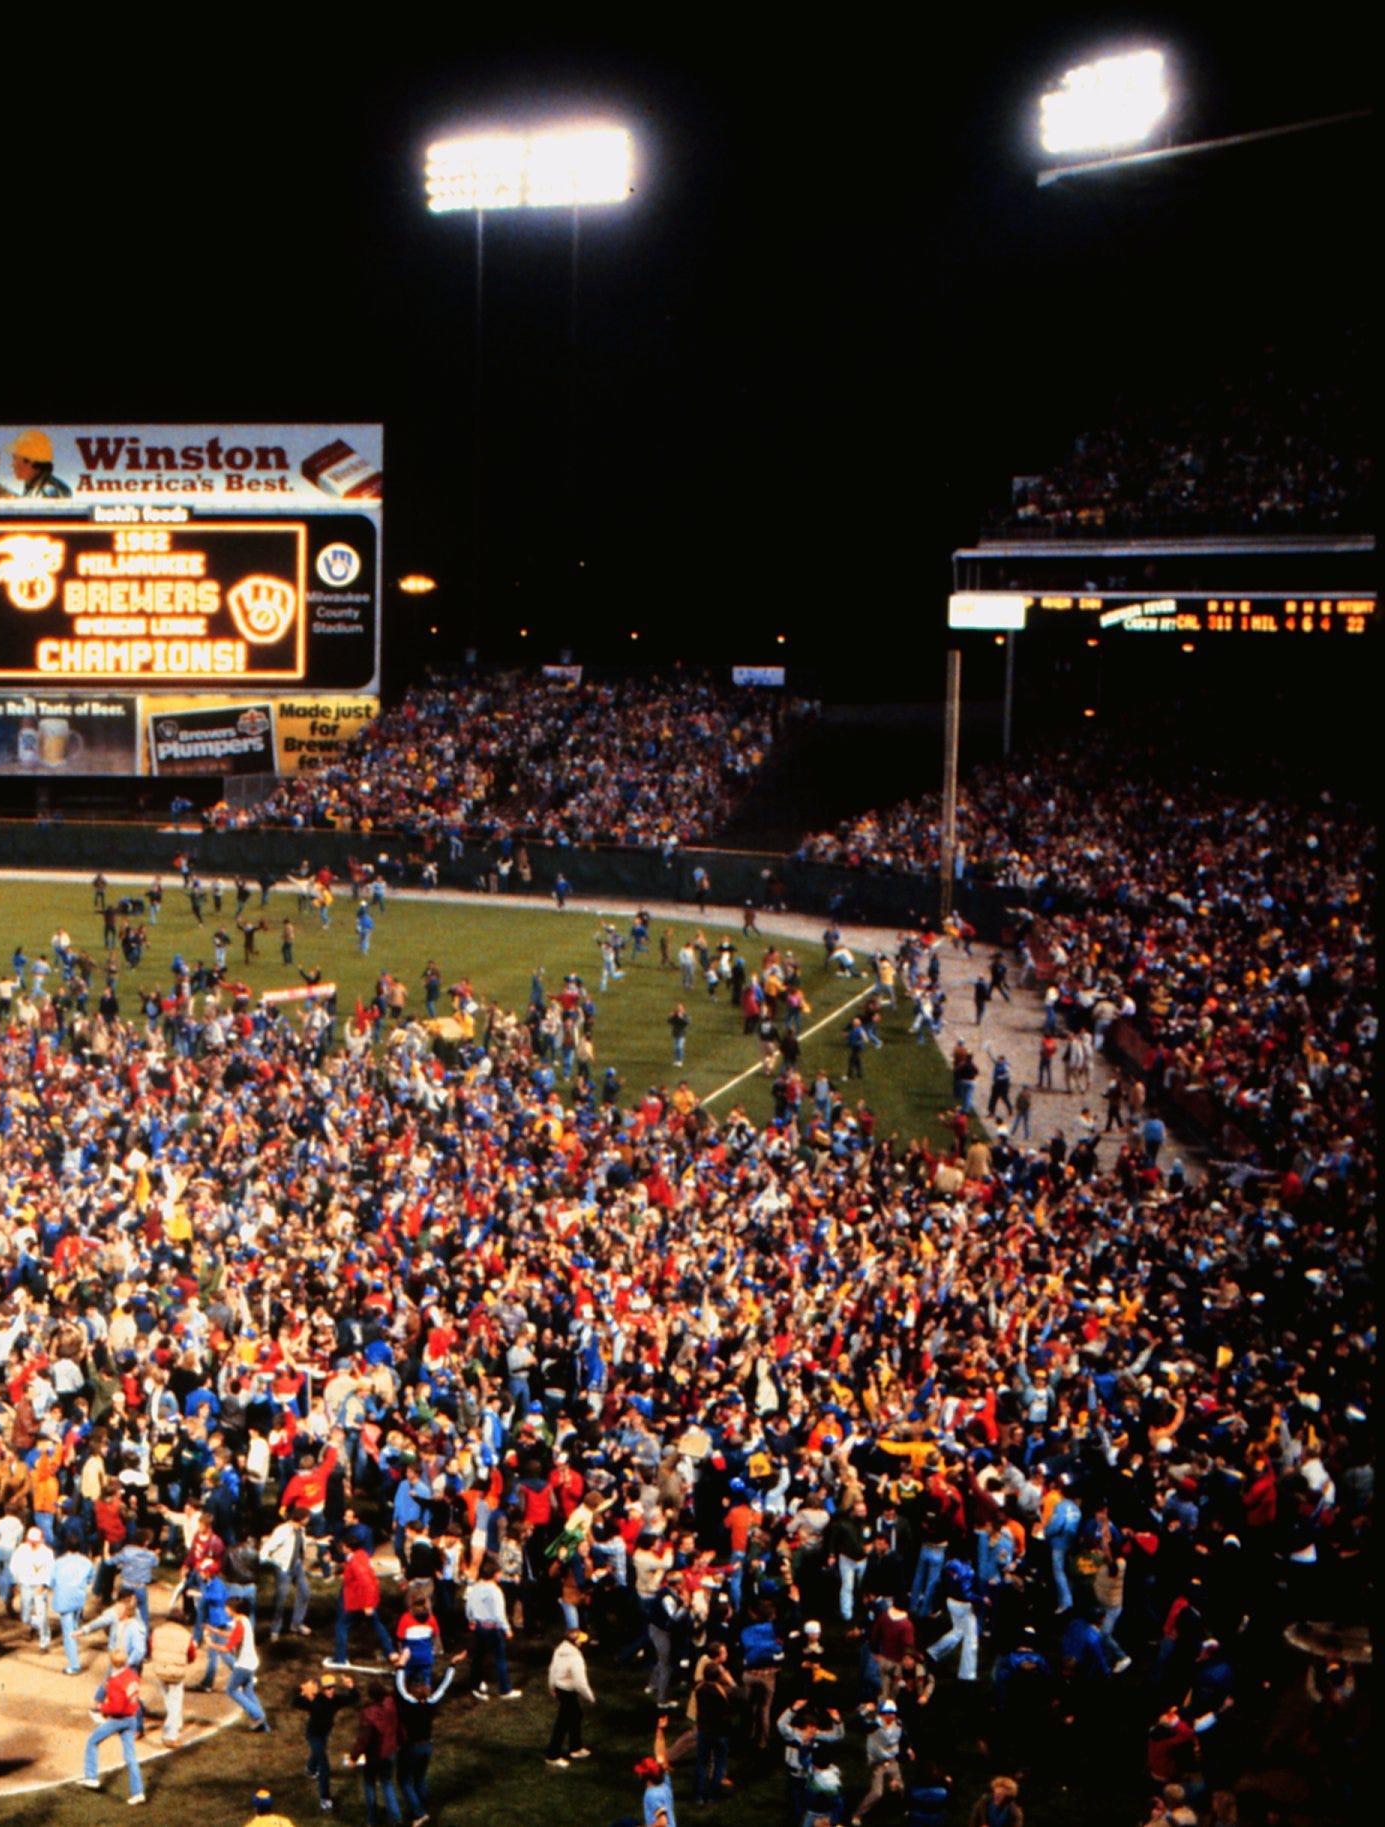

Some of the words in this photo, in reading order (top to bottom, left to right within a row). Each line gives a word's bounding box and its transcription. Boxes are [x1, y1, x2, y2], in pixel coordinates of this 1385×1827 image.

[74, 436, 290, 471] Winston
[76, 473, 214, 493] America's
[224, 473, 294, 493] Best.
[114, 530, 171, 552] 1982
[77, 553, 207, 577] MILWAUKEE
[63, 579, 221, 614] BREWERS
[306, 591, 371, 604] Milwaukee
[316, 605, 361, 621] County
[311, 621, 364, 635] Stadium
[37, 638, 247, 673] CHAMPIONS!
[38, 701, 72, 716] Taste
[74, 701, 91, 716] of
[279, 703, 332, 718] Made
[334, 702, 373, 721] just
[178, 727, 237, 743] Brewers
[309, 720, 340, 736] for
[156, 736, 265, 761] Plumpers
